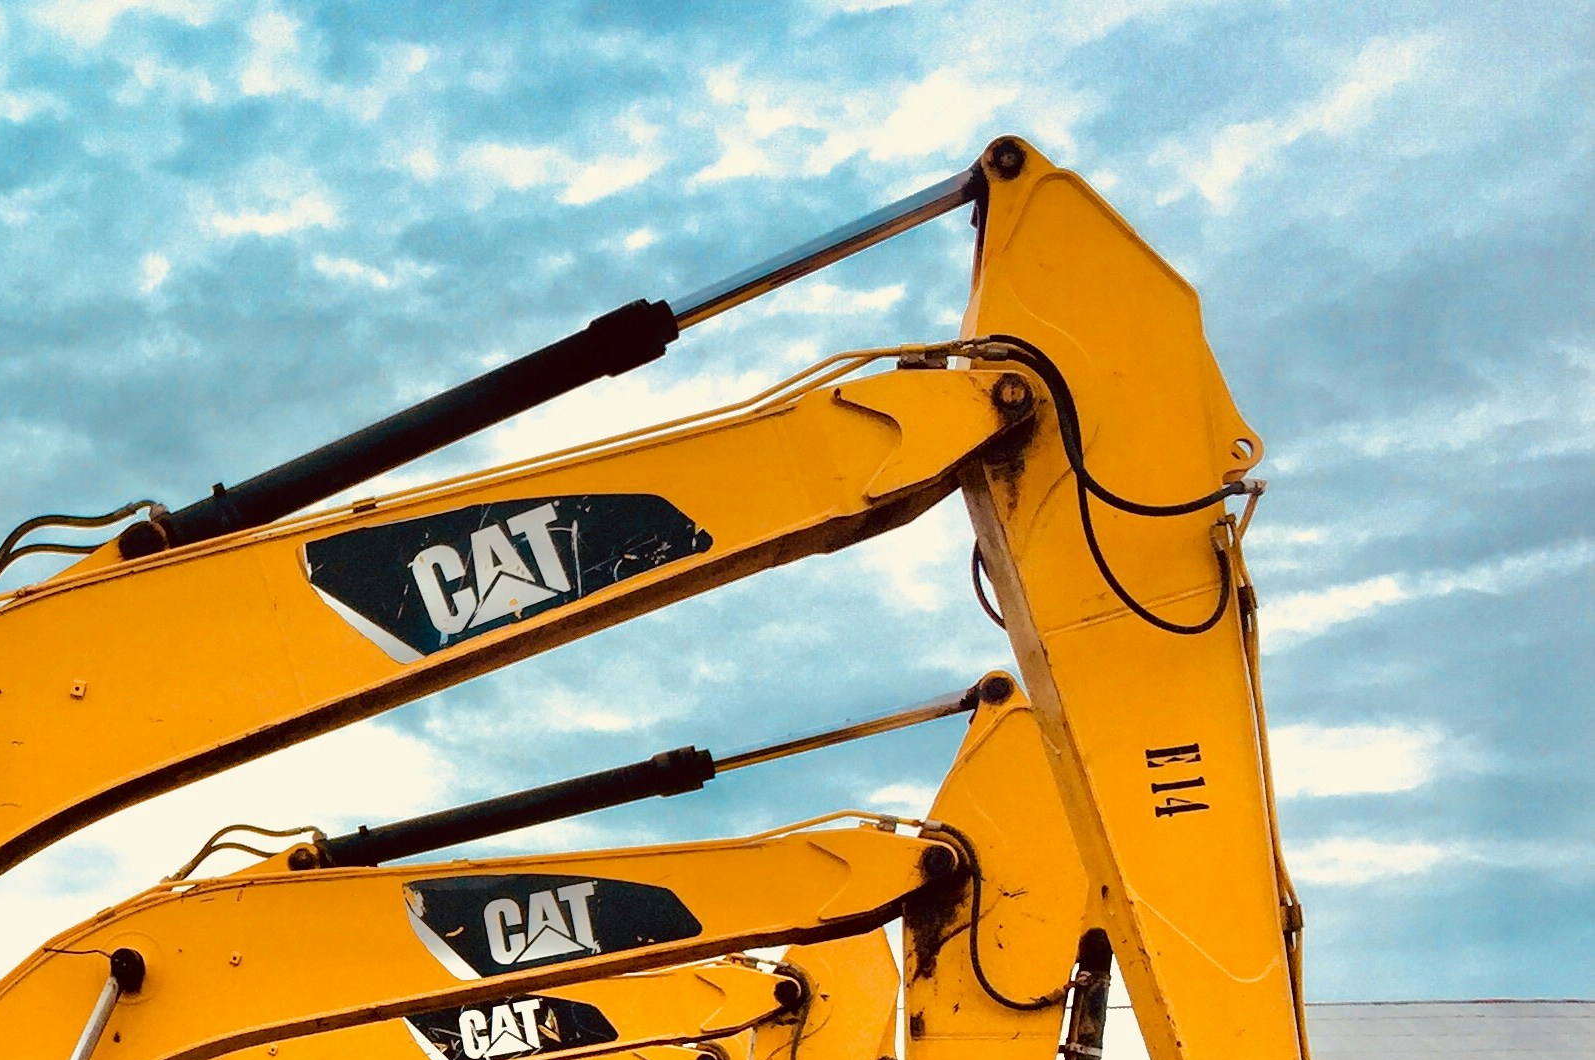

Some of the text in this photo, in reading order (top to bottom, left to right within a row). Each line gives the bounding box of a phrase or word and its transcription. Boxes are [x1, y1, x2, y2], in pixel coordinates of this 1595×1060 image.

[411, 502, 572, 635] CAT
[483, 881, 593, 965] CAT
[458, 998, 542, 1060] CAT
